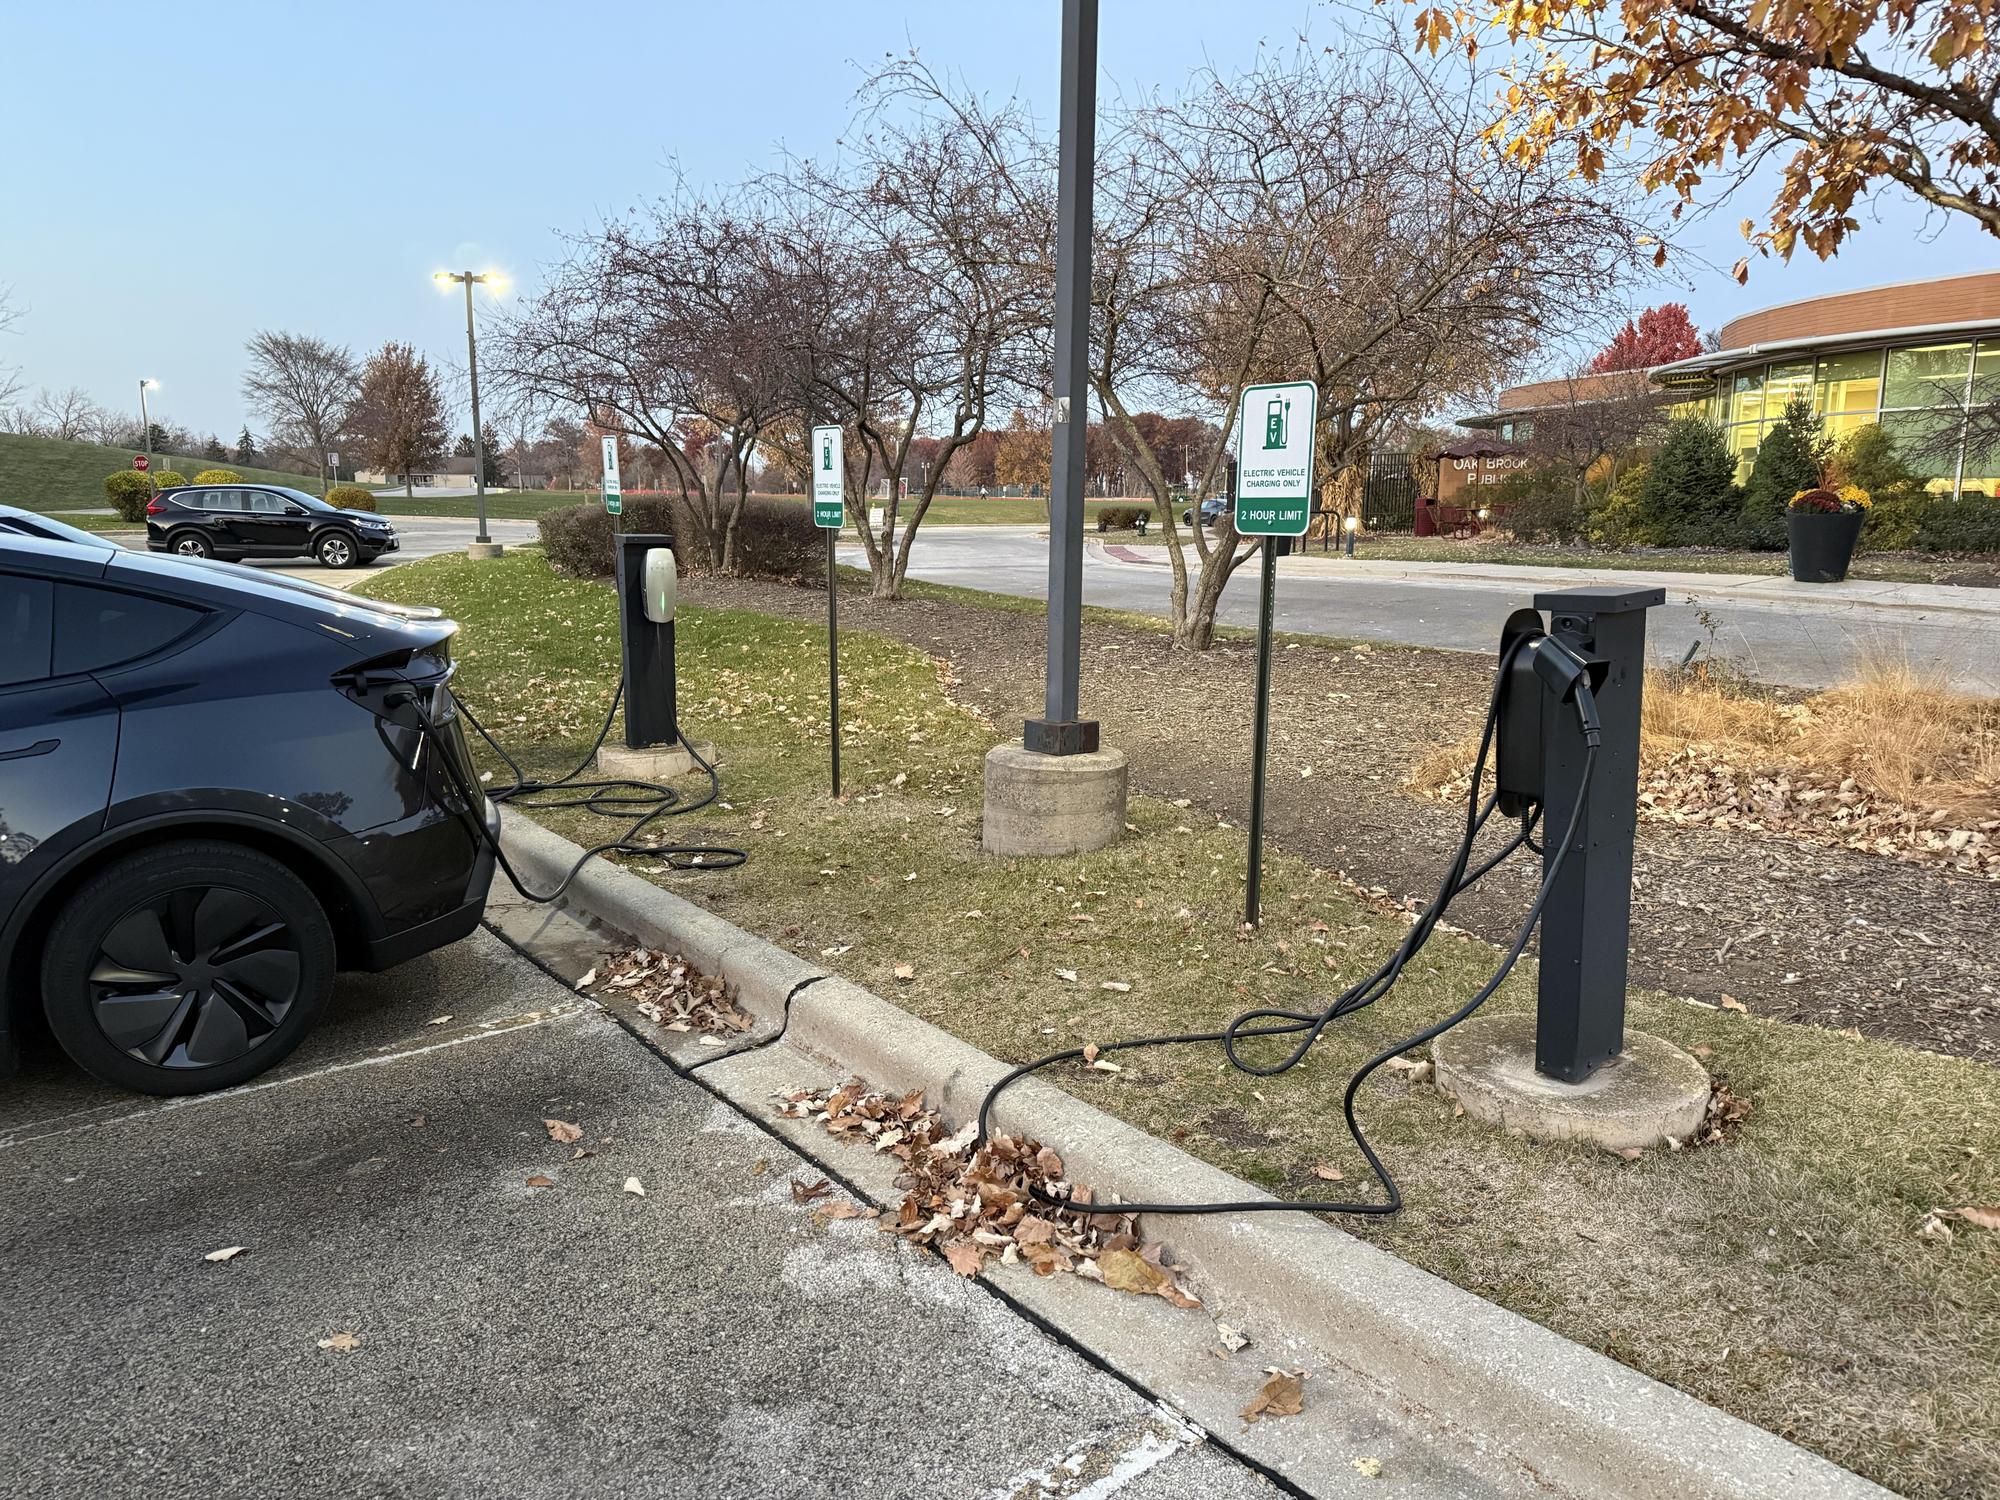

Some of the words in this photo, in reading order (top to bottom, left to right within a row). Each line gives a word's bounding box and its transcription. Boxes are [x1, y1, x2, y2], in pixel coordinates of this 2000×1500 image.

[1454, 458, 1478, 470] OAK
[1486, 458, 1528, 469] BROOK
[1244, 469, 1274, 477] ELECTRIC
[1242, 511, 1246, 520] 2
[1250, 511, 1275, 520] HOUR
[1279, 511, 1303, 520] LIMIT
